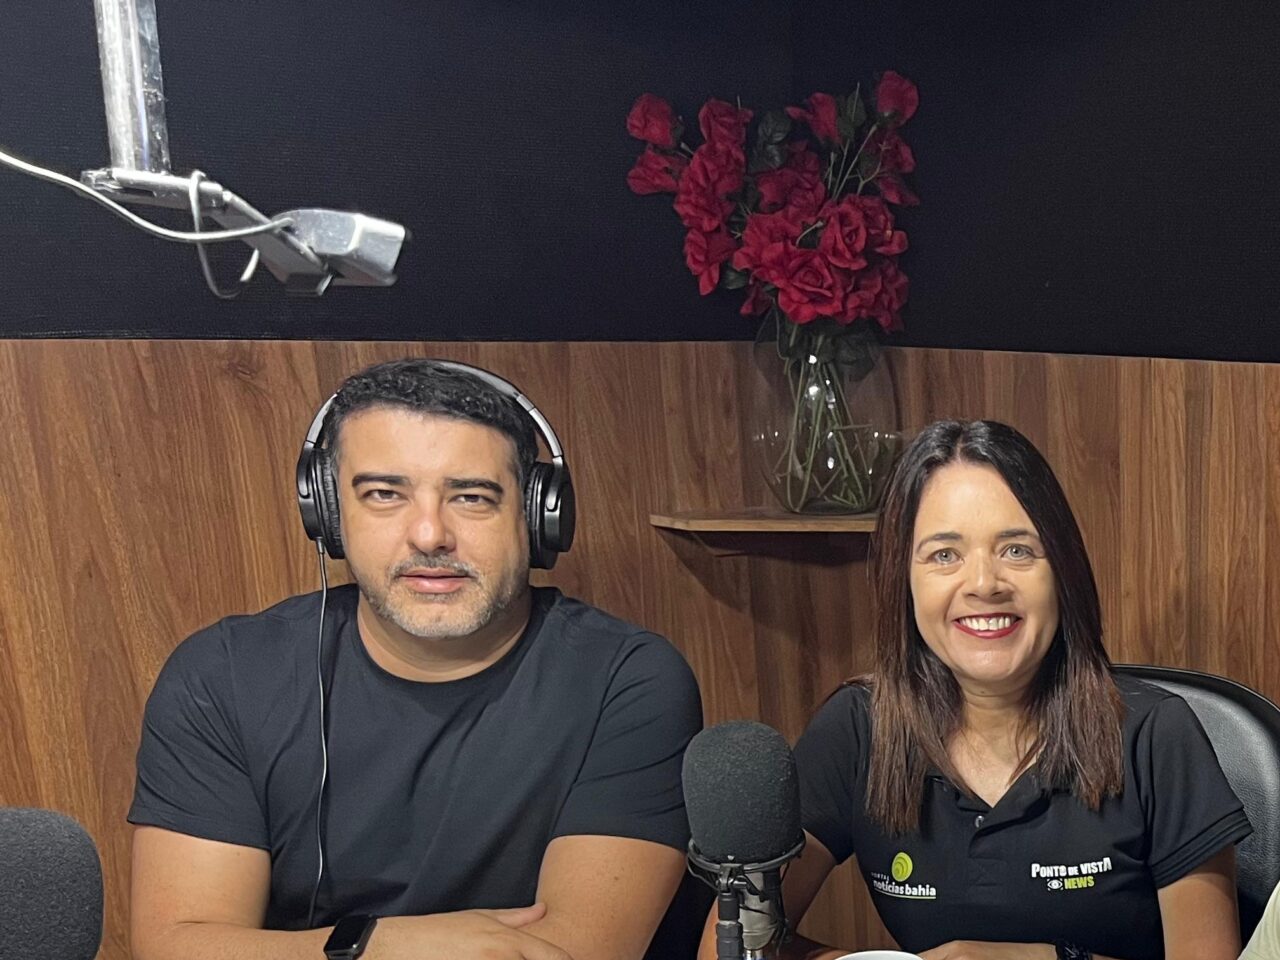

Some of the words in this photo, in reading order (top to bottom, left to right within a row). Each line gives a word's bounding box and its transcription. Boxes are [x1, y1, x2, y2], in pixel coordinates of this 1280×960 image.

[1031, 863, 1066, 878] PONTO
[1067, 866, 1078, 876] DE
[1080, 857, 1112, 874] VISTA
[1064, 876, 1094, 890] NEWS
